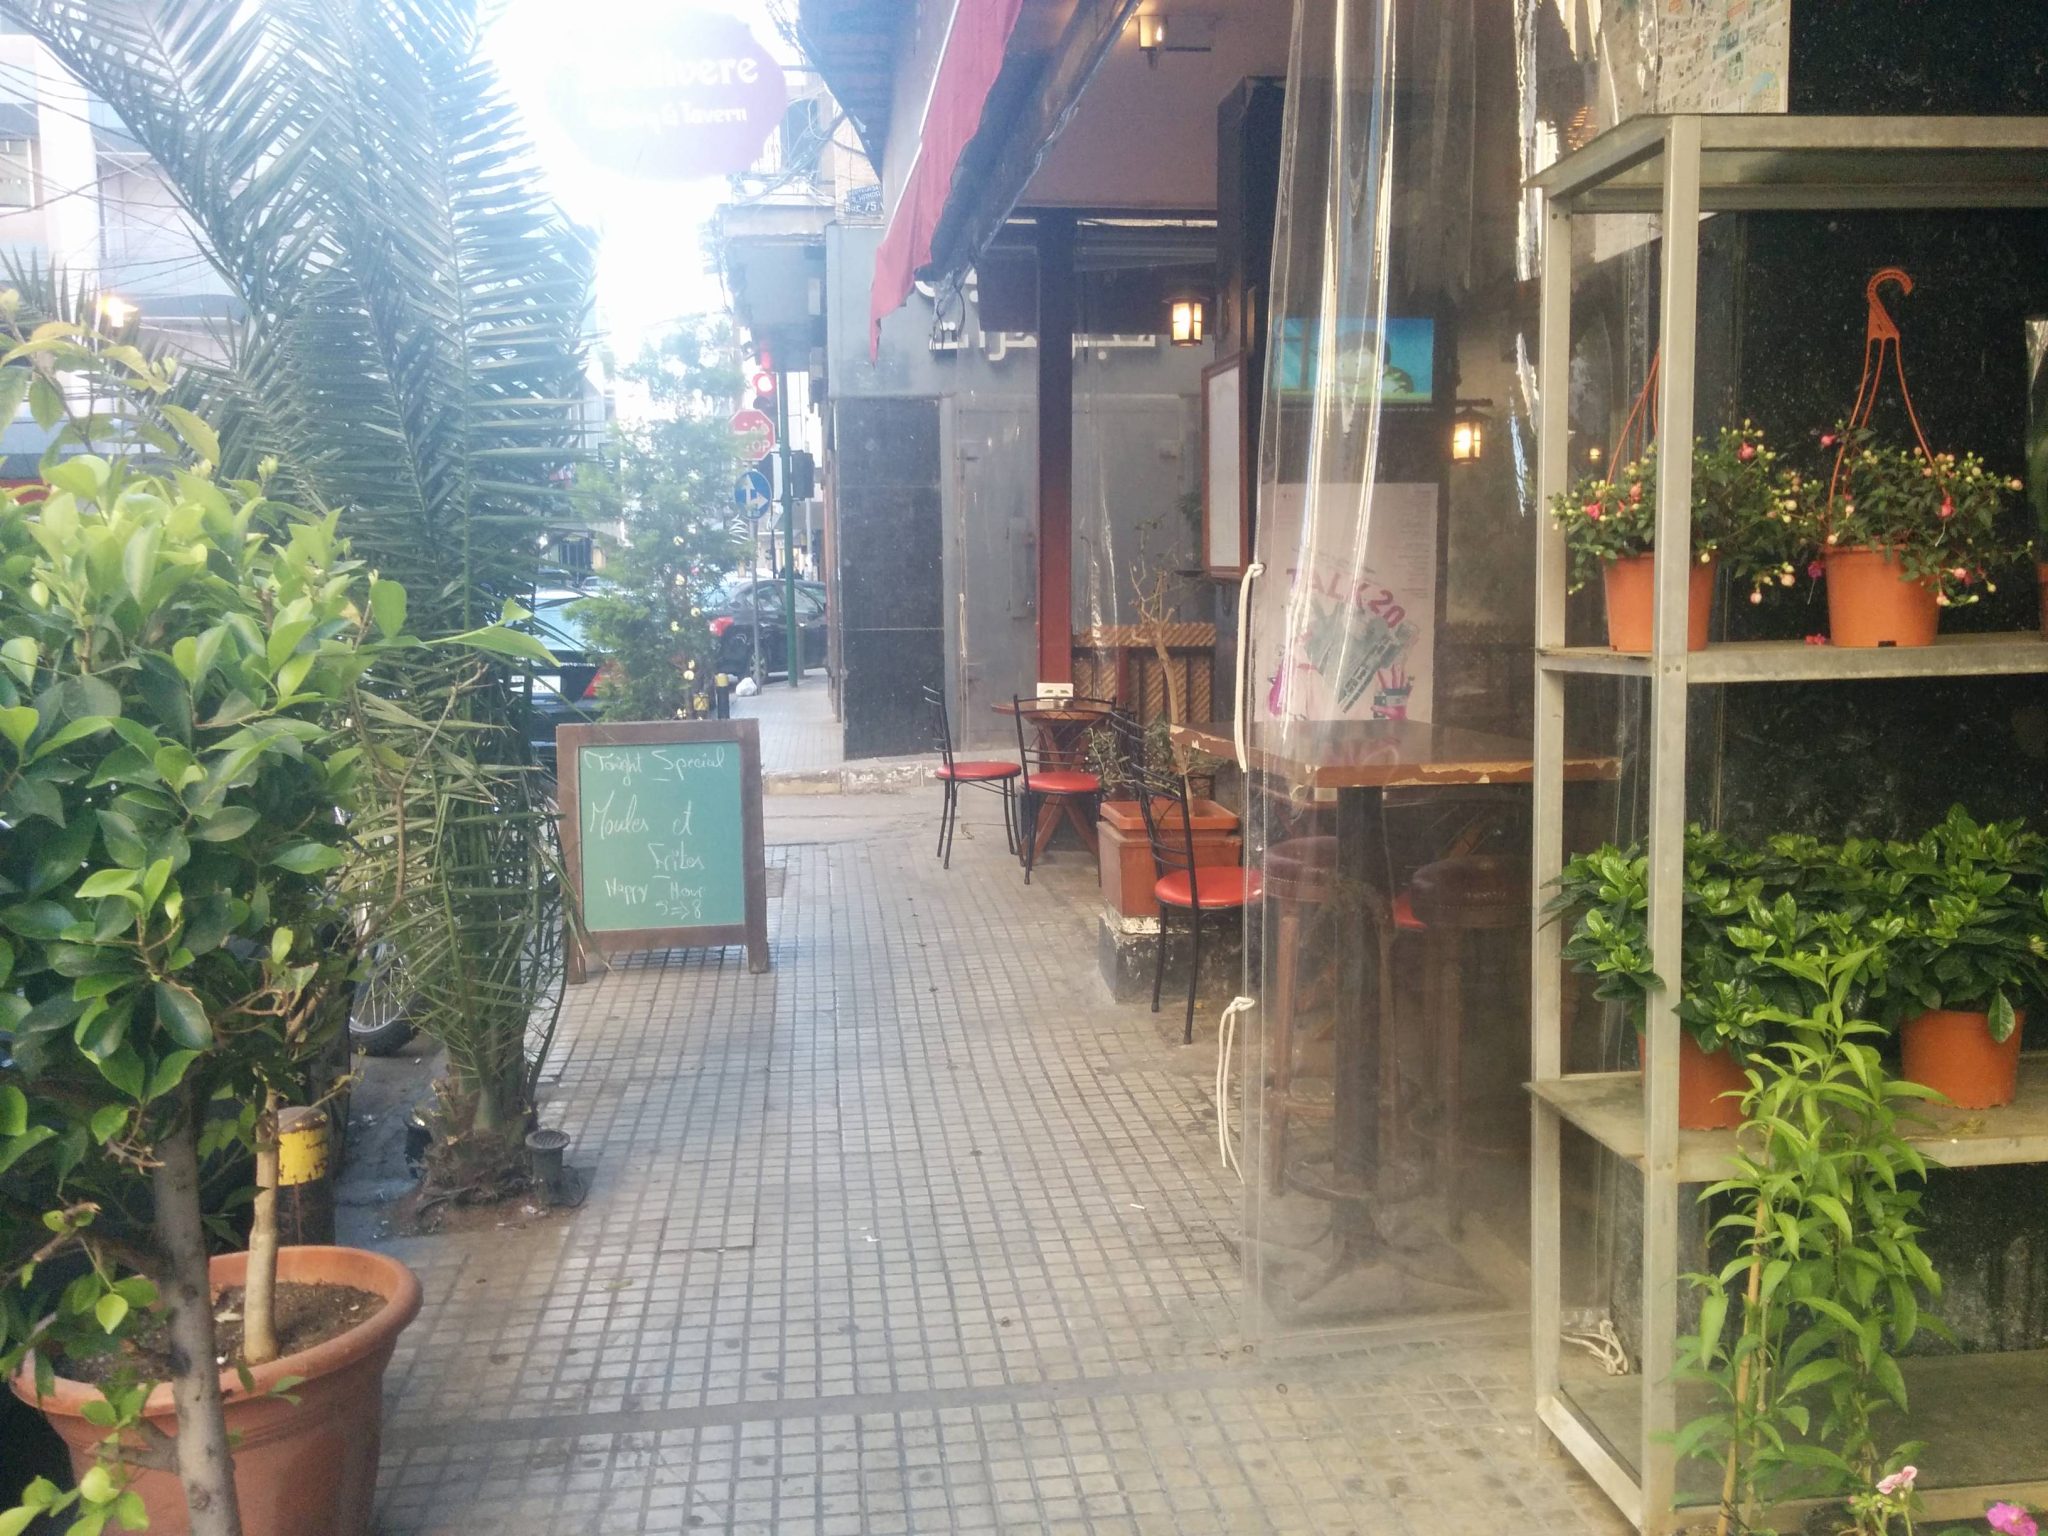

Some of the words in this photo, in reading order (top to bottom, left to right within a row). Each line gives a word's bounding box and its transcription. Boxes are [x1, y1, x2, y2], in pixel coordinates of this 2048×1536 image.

[651, 745, 725, 781] Special
[673, 800, 693, 836] et
[605, 877, 649, 905] Happy
[670, 880, 704, 900] Hour
